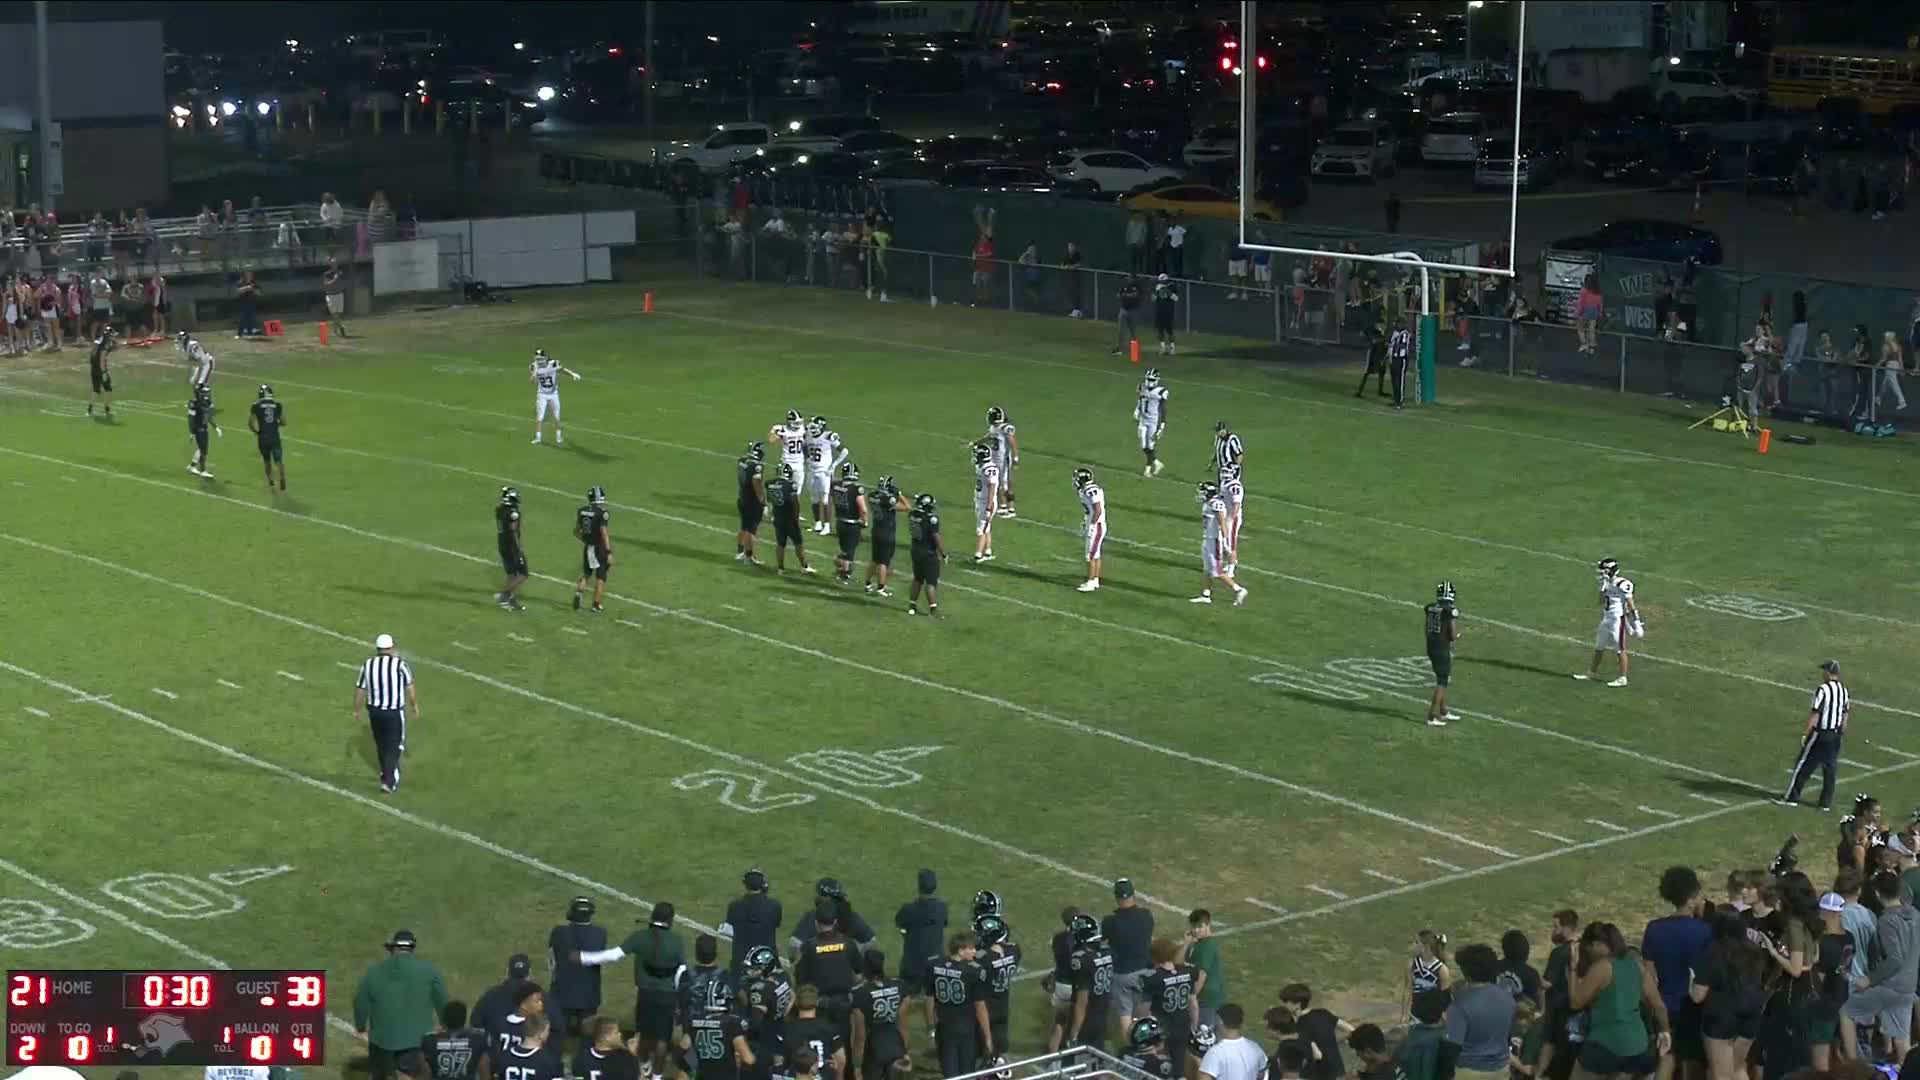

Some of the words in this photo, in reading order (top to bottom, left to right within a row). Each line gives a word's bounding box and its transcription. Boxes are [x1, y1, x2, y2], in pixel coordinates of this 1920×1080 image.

[539, 376, 554, 388] 23
[788, 440, 803, 454] 20
[672, 749, 922, 813] 20
[935, 977, 966, 1005] 88
[694, 1029, 725, 1059] 45
